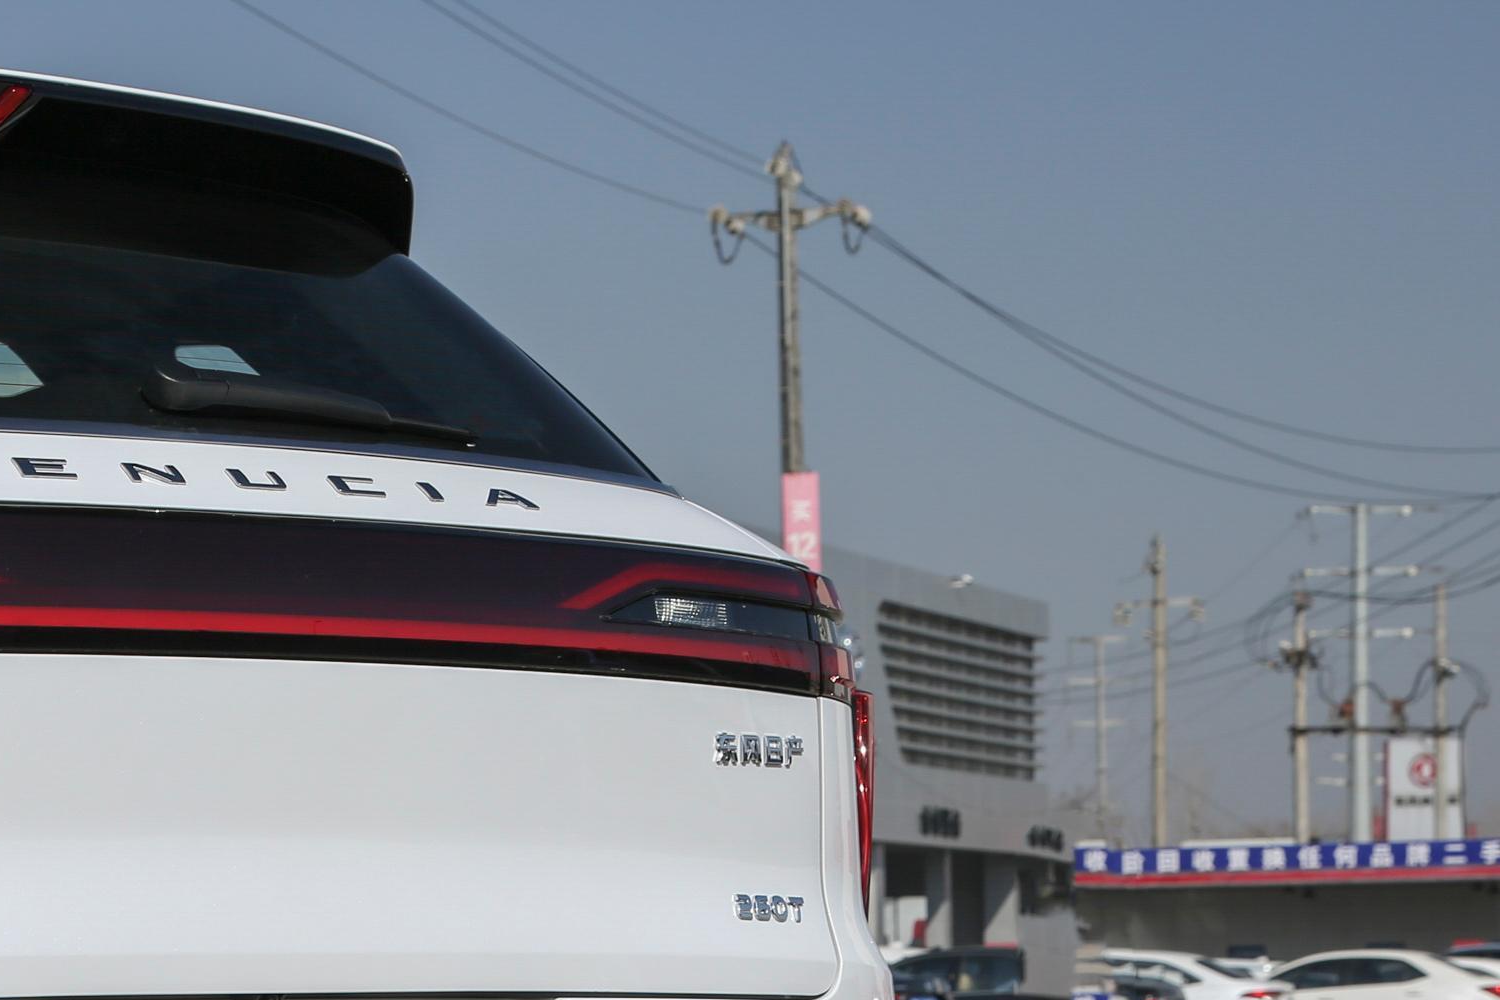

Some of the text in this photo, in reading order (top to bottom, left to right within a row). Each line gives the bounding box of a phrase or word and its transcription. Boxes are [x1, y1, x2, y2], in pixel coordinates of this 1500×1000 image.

[714, 732, 805, 768] 东风日产
[732, 894, 805, 923] 250T
